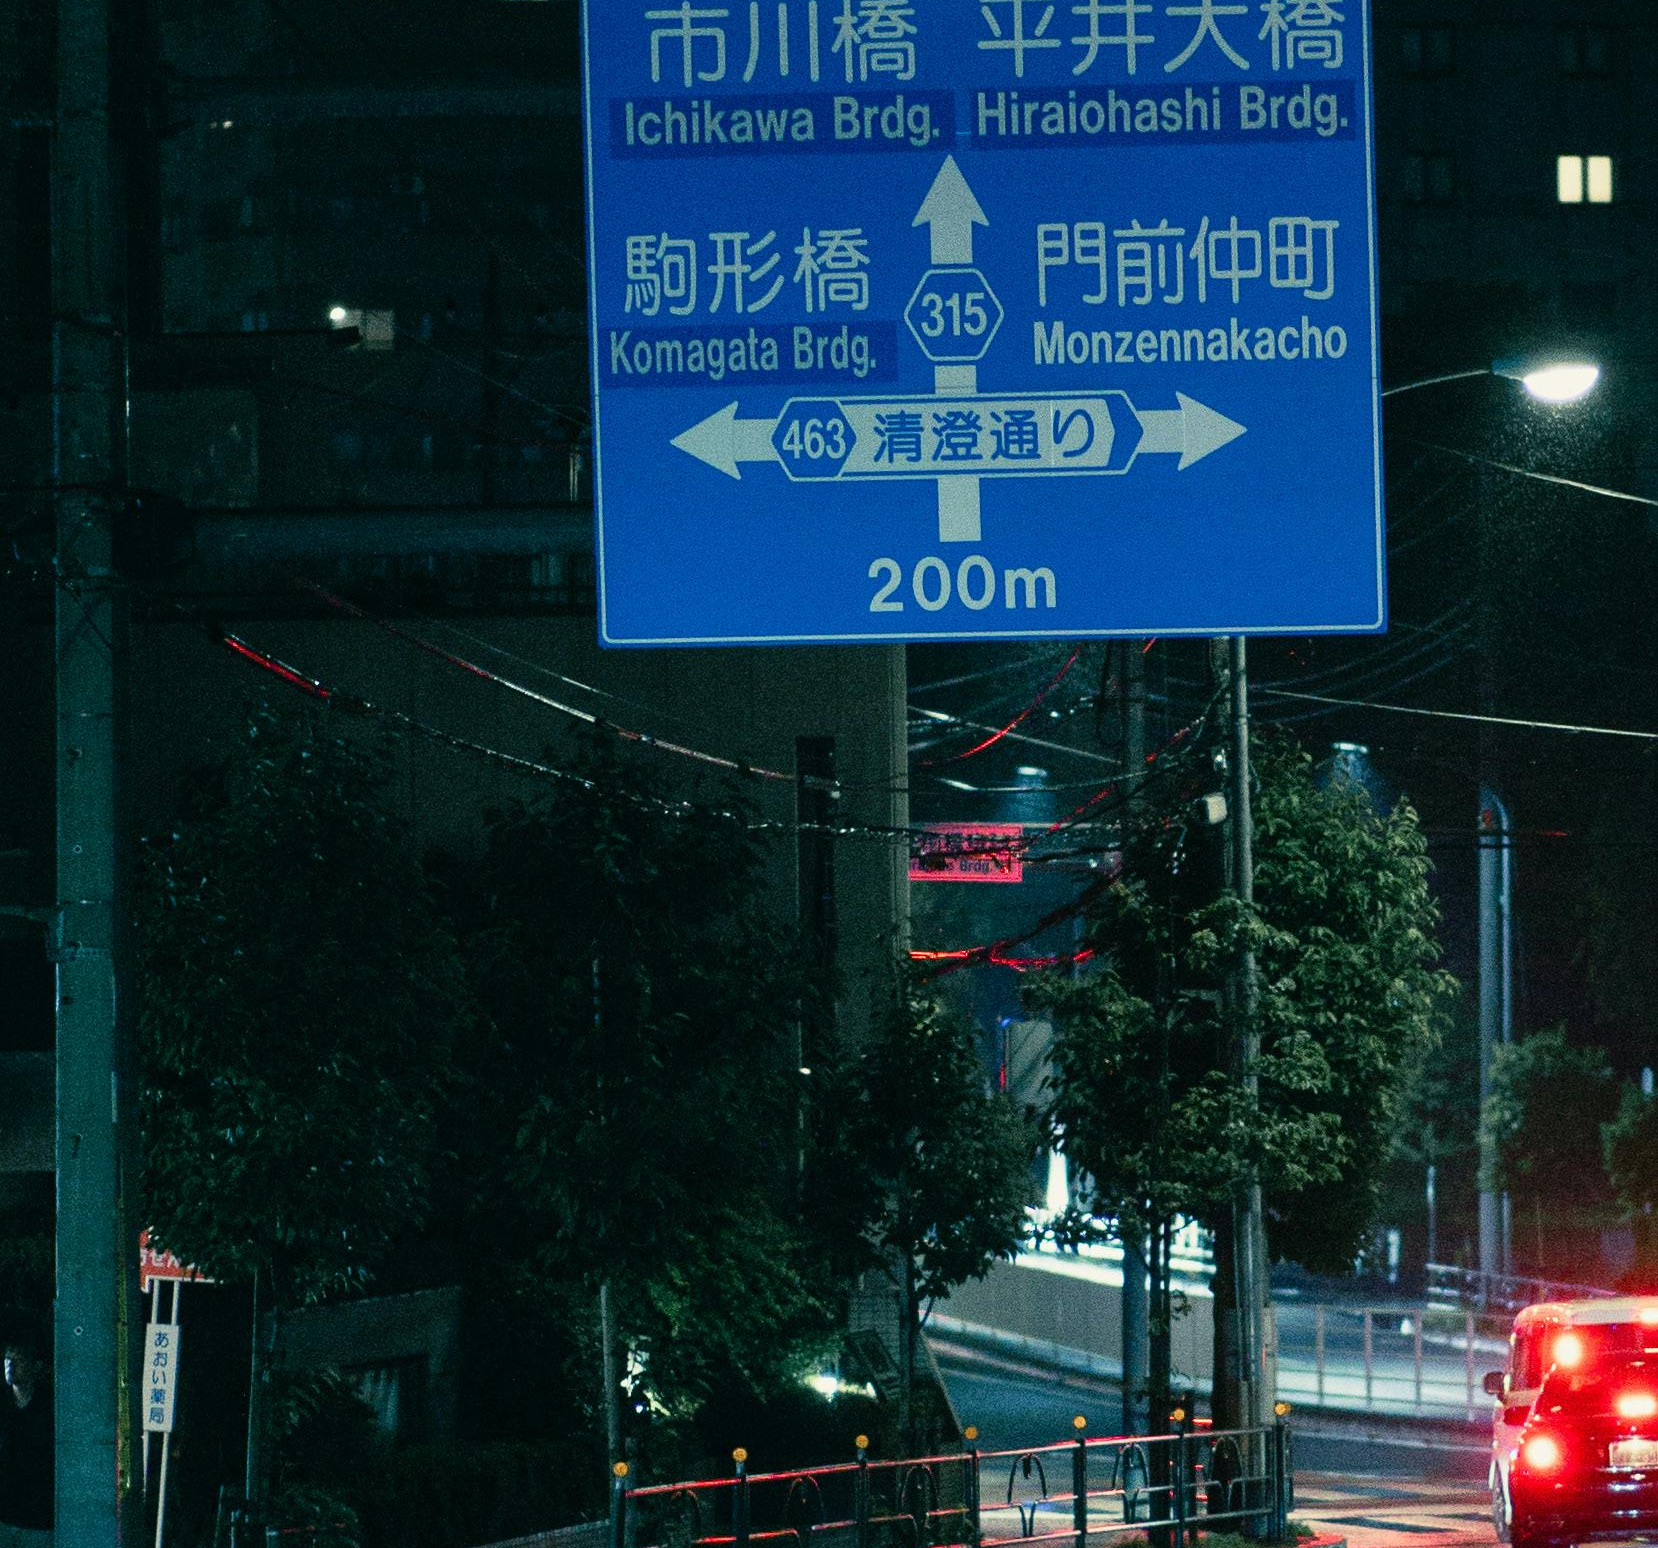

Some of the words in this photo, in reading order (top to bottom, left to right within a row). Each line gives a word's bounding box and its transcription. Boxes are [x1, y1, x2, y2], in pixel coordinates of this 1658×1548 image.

[625, 100, 815, 146] Ichikawa
[833, 94, 940, 146] Brdg.
[978, 86, 1221, 136] Hiraiohashi
[1239, 84, 1349, 137] Brdg.
[624, 227, 870, 316] 駒形橋
[1037, 215, 1340, 307] 門前仲町
[921, 292, 988, 337] 315
[1034, 316, 1348, 365] Monzennakacho
[610, 328, 779, 381] Komagata
[793, 325, 877, 376] Brdg.
[782, 413, 848, 460] 463
[873, 408, 1096, 464] 清澄通り
[868, 556, 1058, 613] 200m
[150, 1331, 169, 1424] あおい薬局
